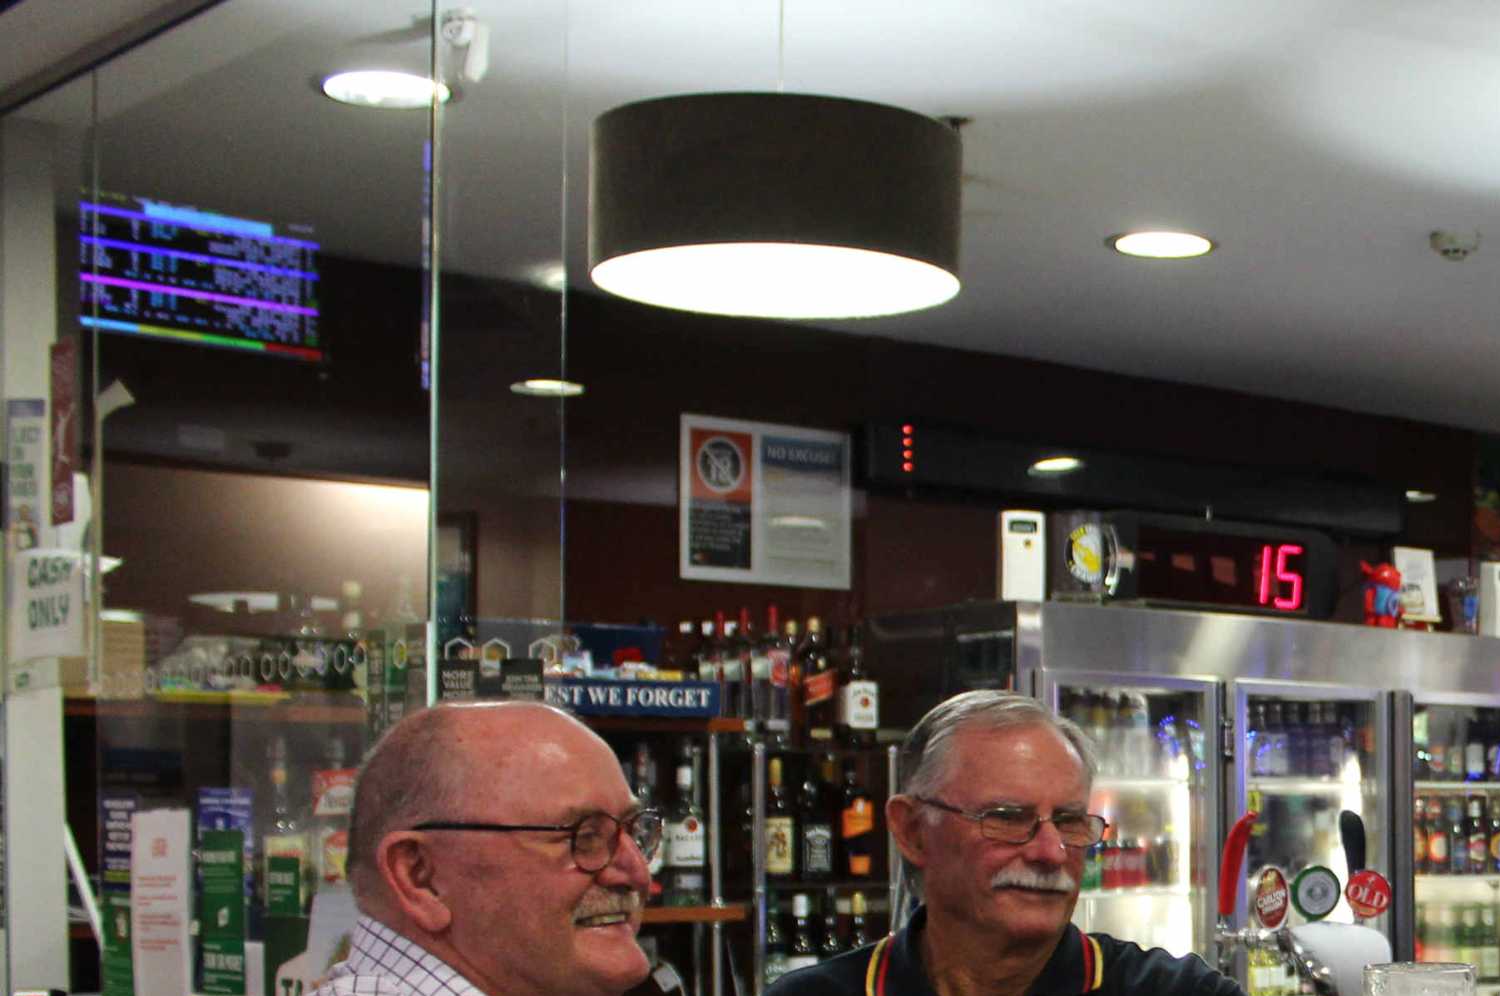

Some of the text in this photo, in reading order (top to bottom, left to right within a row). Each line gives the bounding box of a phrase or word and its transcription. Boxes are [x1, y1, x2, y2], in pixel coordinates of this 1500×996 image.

[28, 556, 71, 588] CASH
[1259, 544, 1304, 611] 15
[28, 593, 70, 629] ONLY
[543, 686, 582, 705] EST
[588, 686, 622, 705] WE
[626, 687, 711, 707] FORGET
[1347, 883, 1388, 907] OLD
